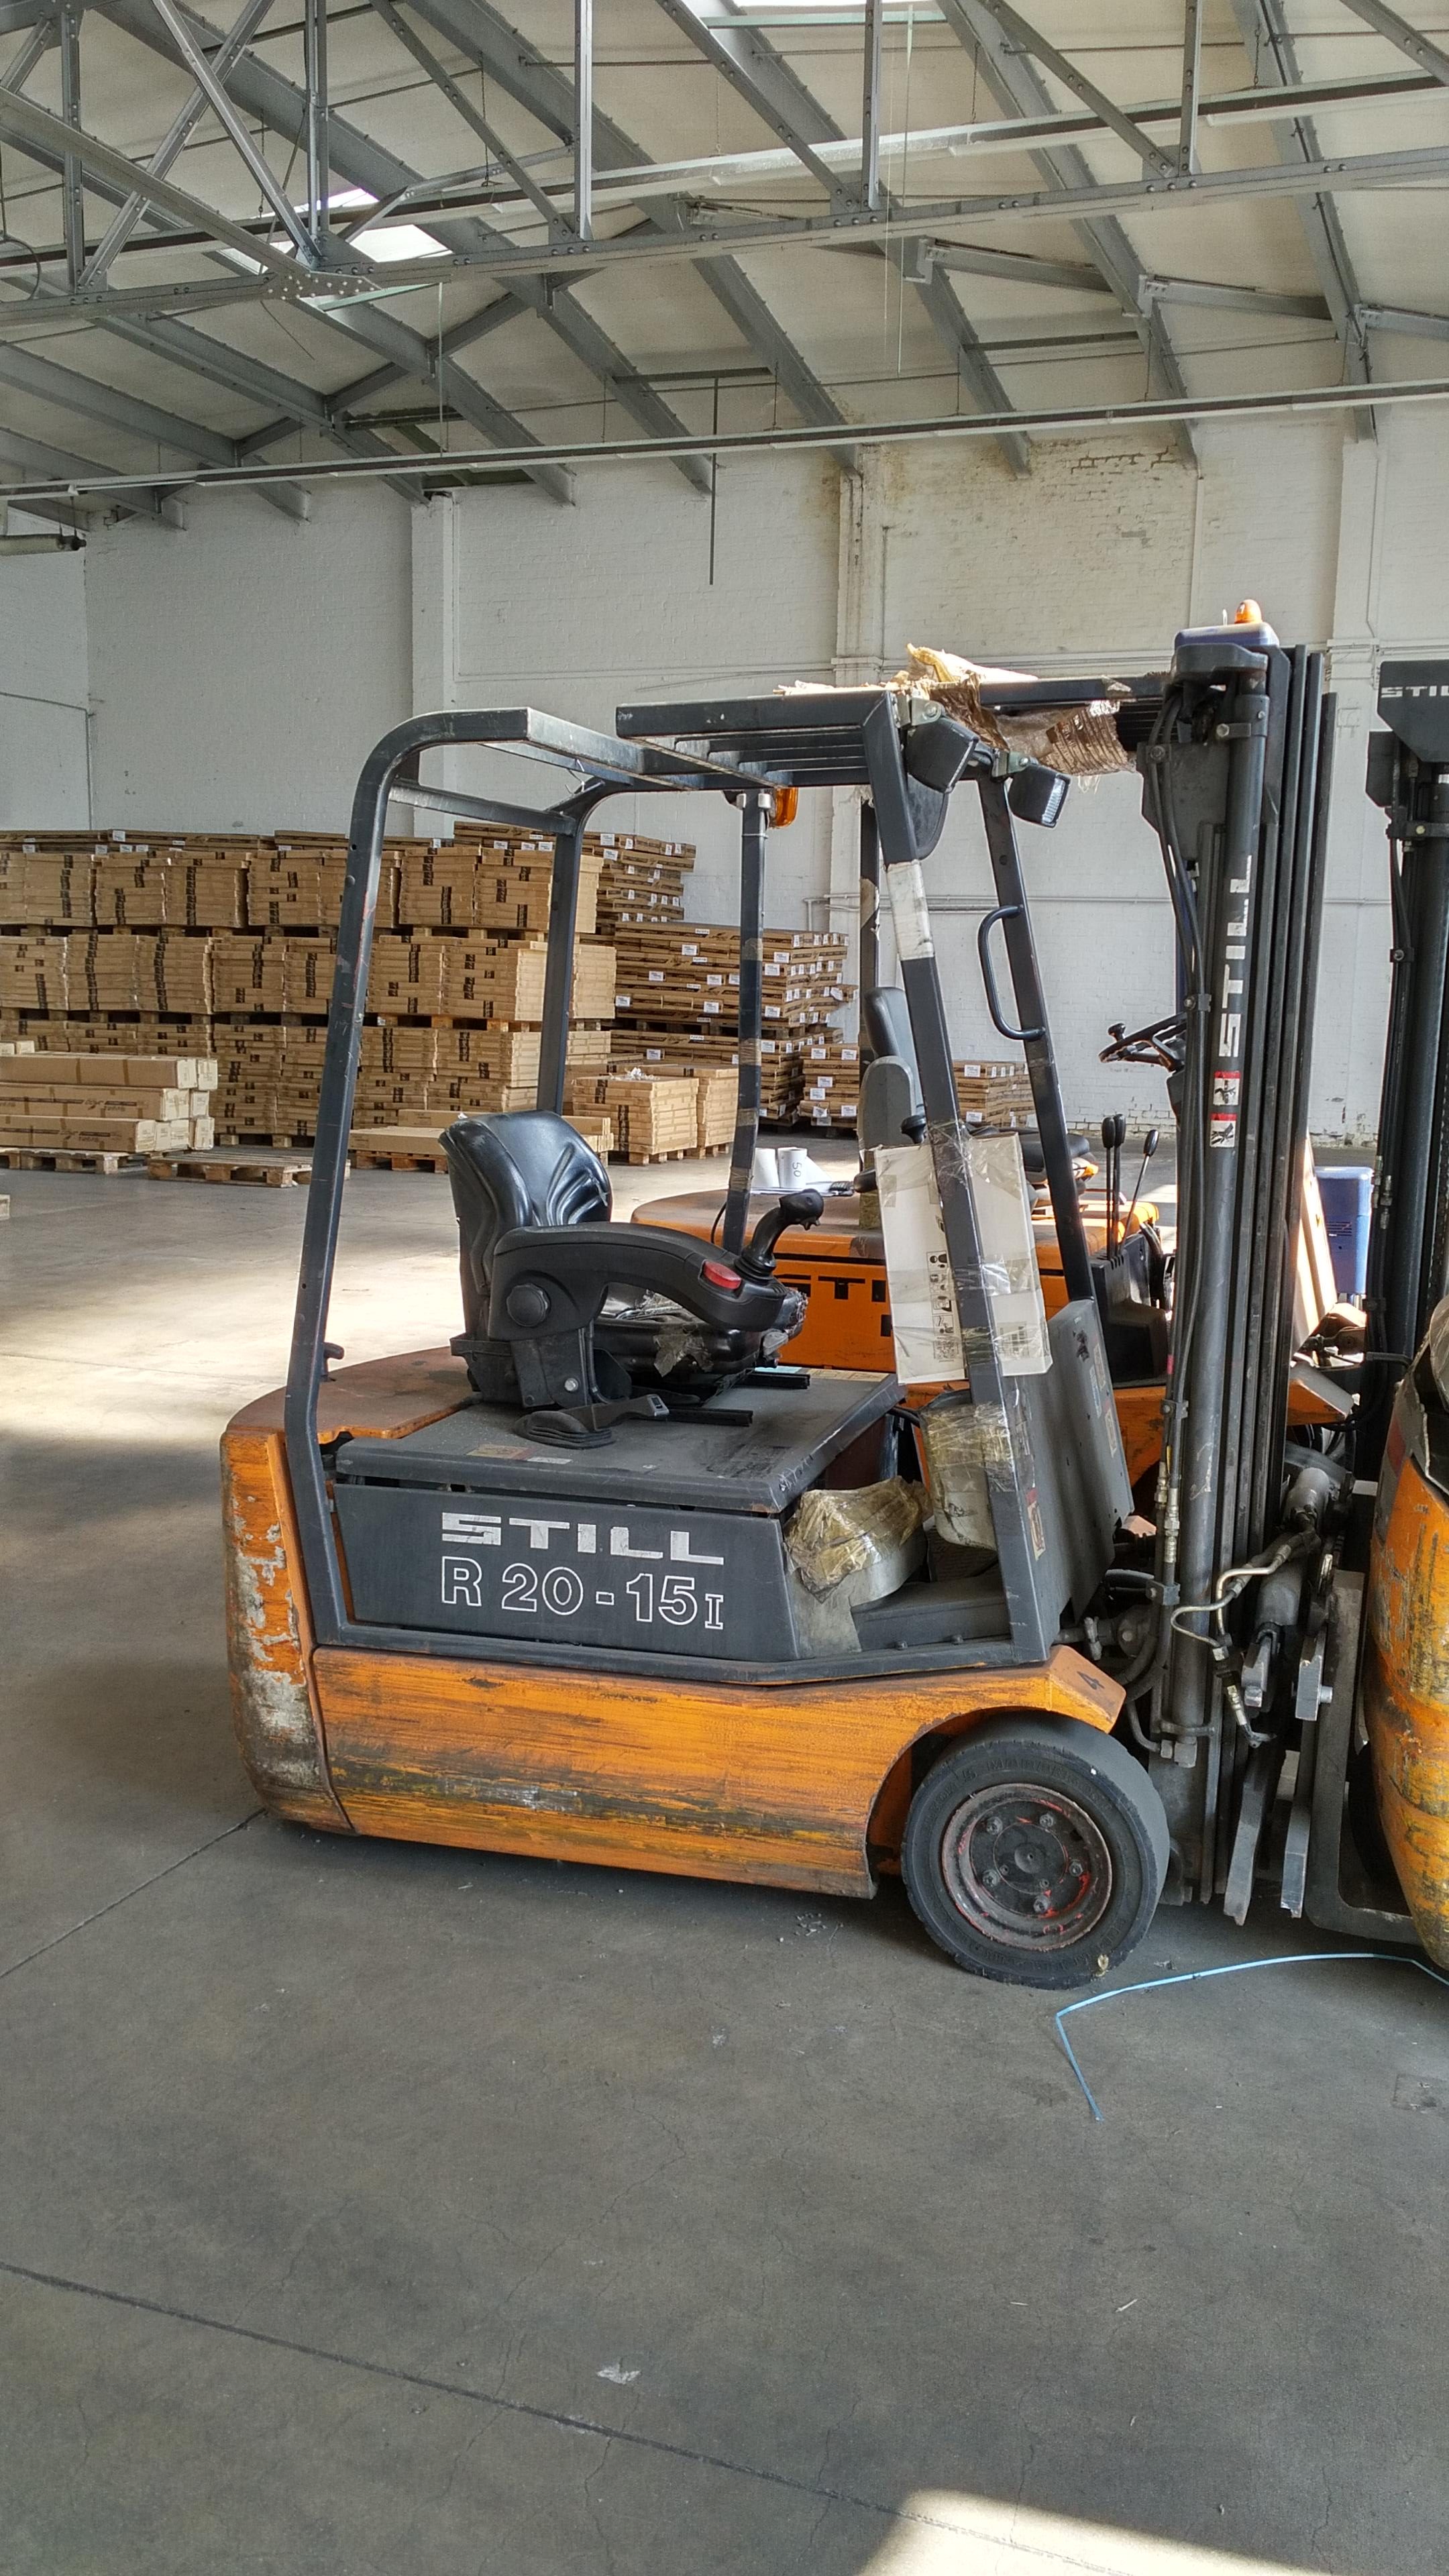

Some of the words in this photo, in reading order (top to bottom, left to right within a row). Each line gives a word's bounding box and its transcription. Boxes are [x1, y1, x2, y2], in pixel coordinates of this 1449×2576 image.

[1381, 685, 1449, 698] STIL
[1218, 855, 1252, 1057] STILL
[441, 1512, 724, 1566] STILL
[441, 1556, 482, 1607] R
